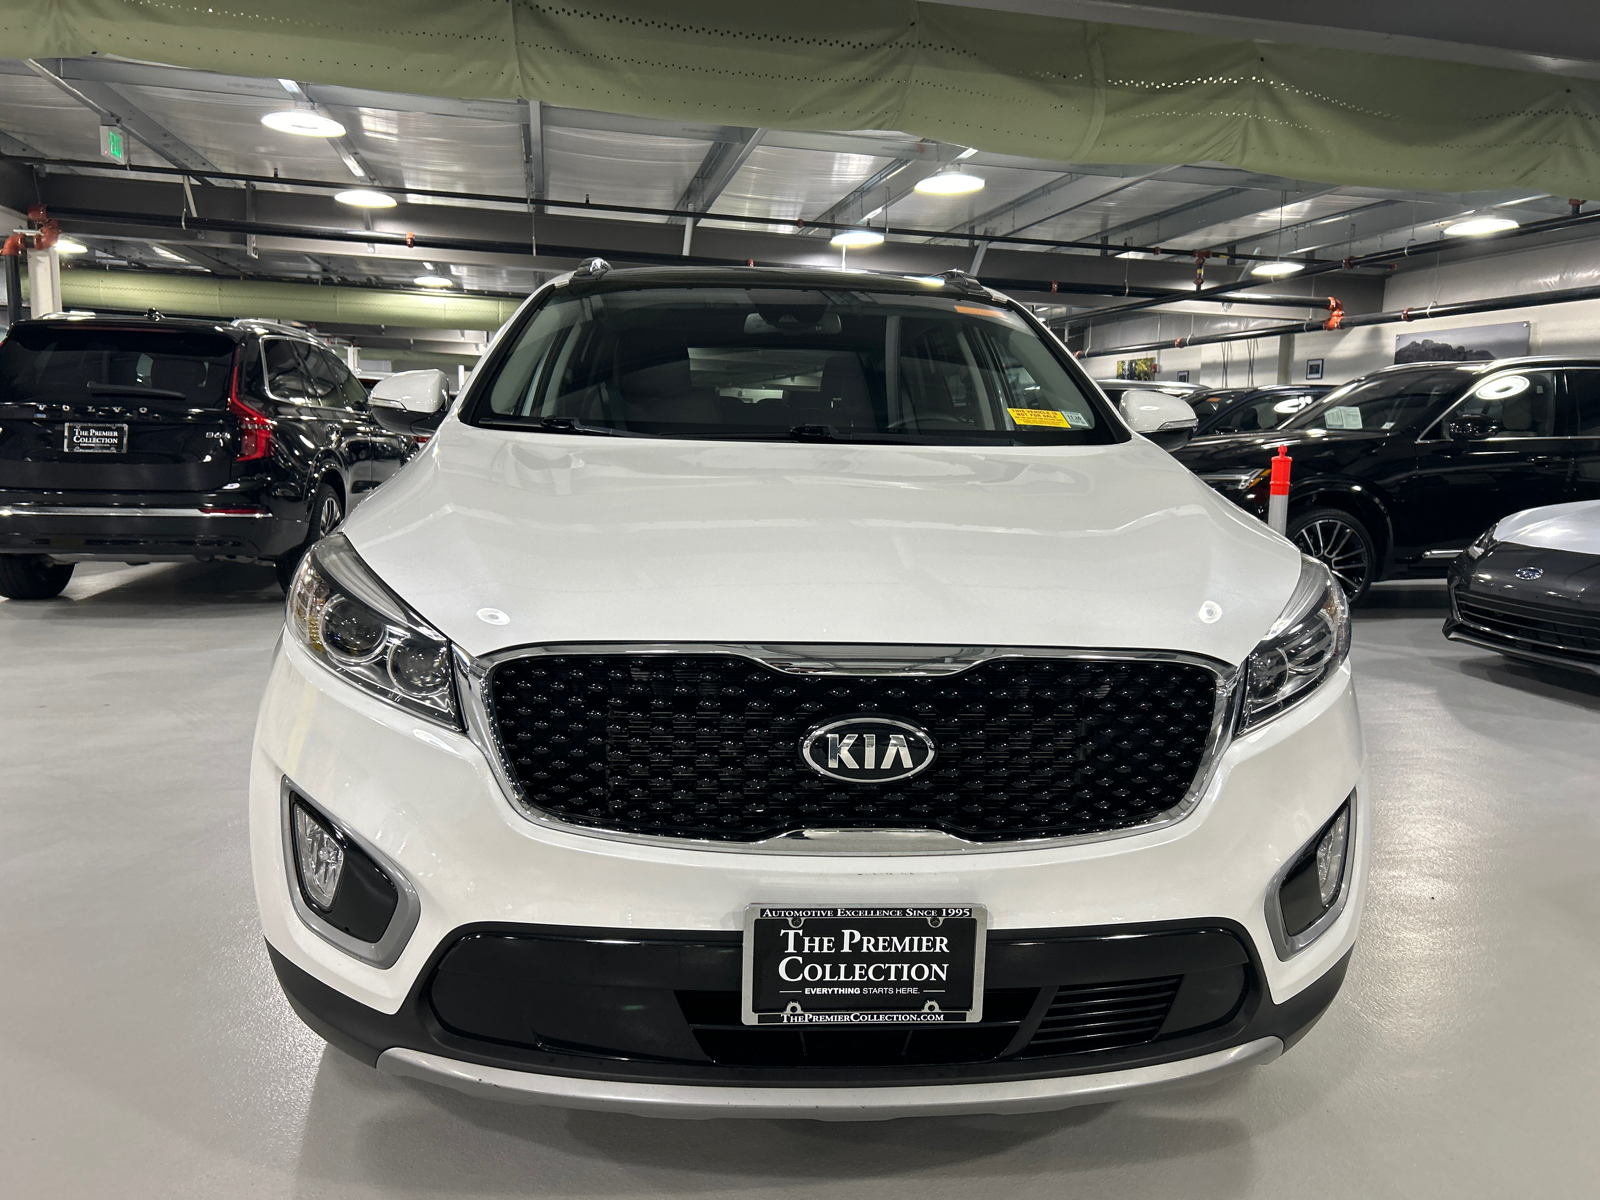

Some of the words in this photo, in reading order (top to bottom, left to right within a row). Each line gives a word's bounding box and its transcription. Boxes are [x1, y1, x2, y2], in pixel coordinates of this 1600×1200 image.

[37, 404, 148, 413] VOLVO
[73, 428, 89, 436] THE
[89, 428, 119, 437] PREMIER
[73, 435, 118, 444] COLLECTION
[826, 734, 914, 769] KIA
[762, 908, 834, 917] AUTOMOTIVE
[836, 908, 903, 917] EXCELLENCE
[905, 908, 938, 917] SINCE
[941, 908, 971, 917] 1995
[779, 928, 836, 953] THE
[840, 929, 950, 953] PREMIER
[778, 956, 950, 982] COLLECTION
[804, 987, 861, 995] EVERYTHING
[862, 987, 894, 995] STARTS
[895, 987, 921, 995] HERE.
